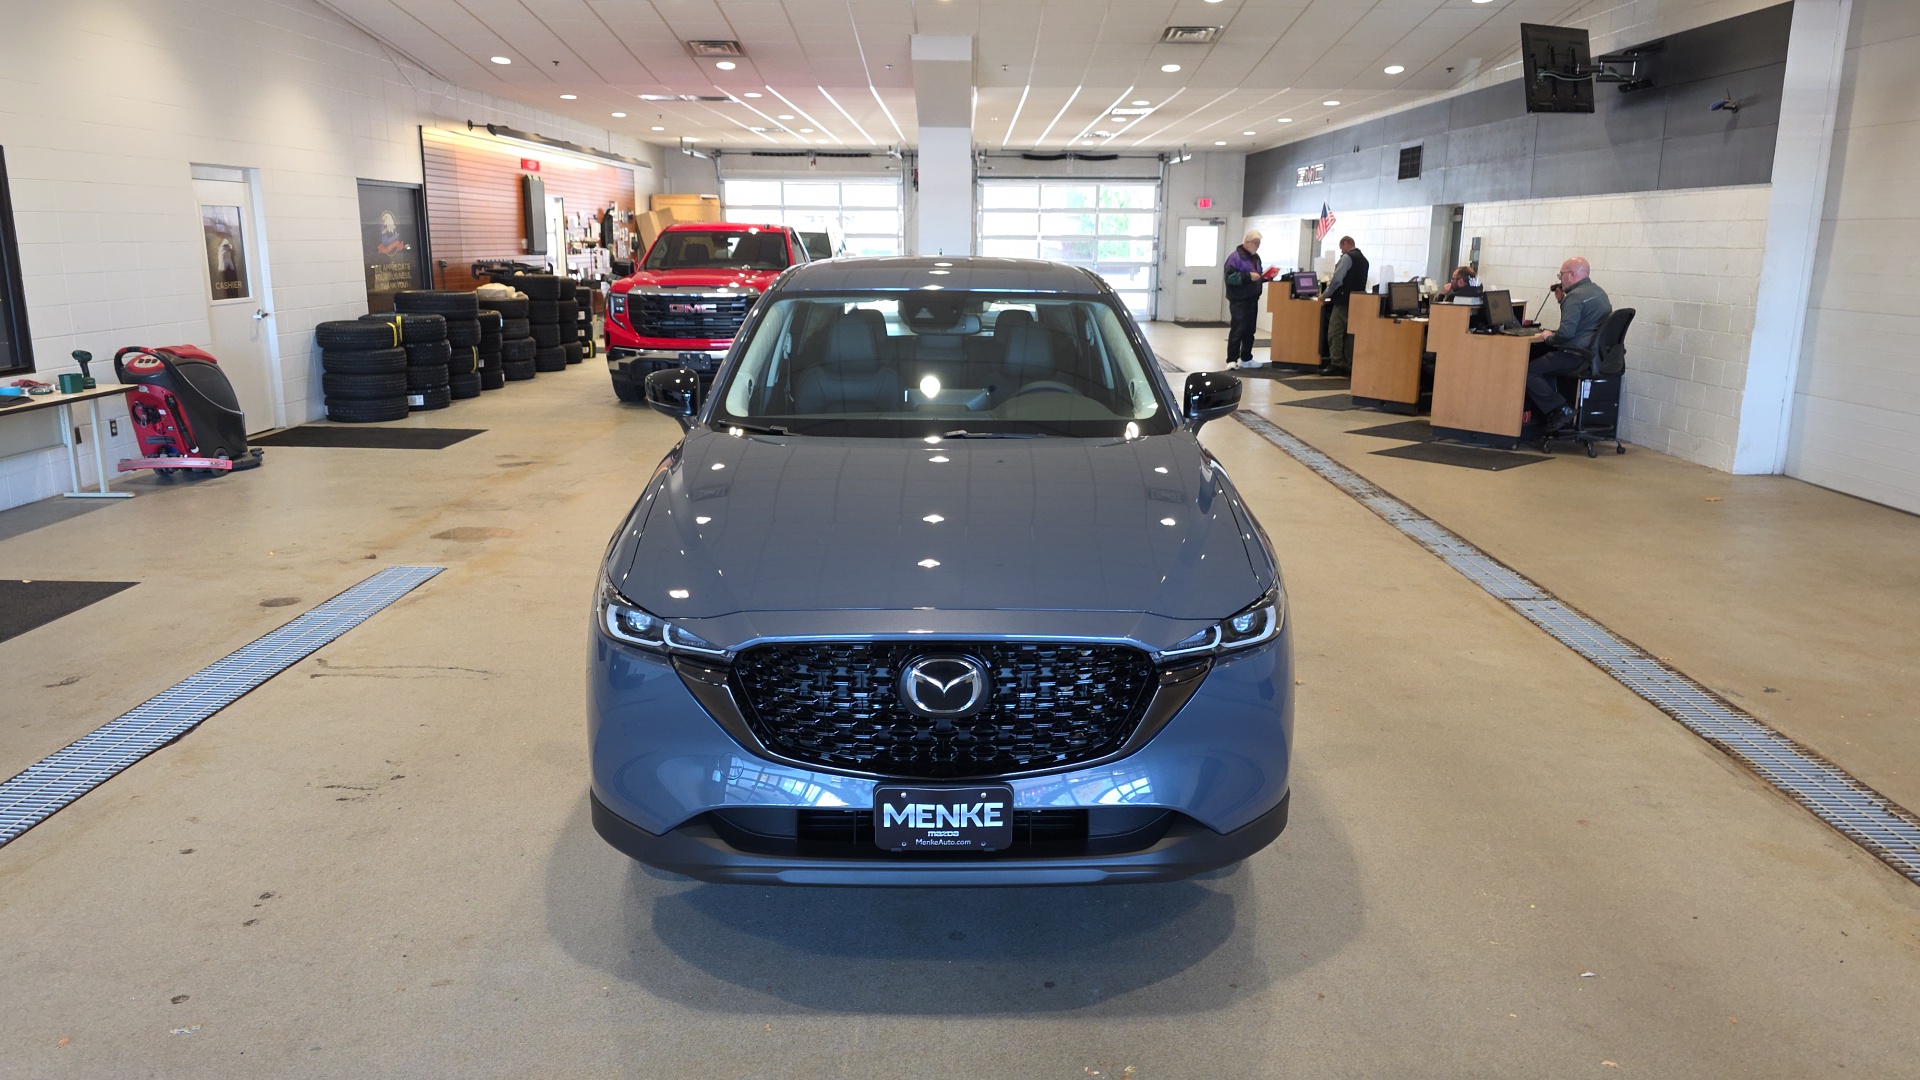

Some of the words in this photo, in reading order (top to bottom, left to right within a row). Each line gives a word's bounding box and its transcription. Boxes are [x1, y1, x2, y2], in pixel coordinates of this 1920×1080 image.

[215, 280, 243, 290] CASHIER
[669, 304, 717, 313] GMC
[883, 802, 1004, 828] MENKE
[915, 838, 971, 846] MenkeAuto.com
